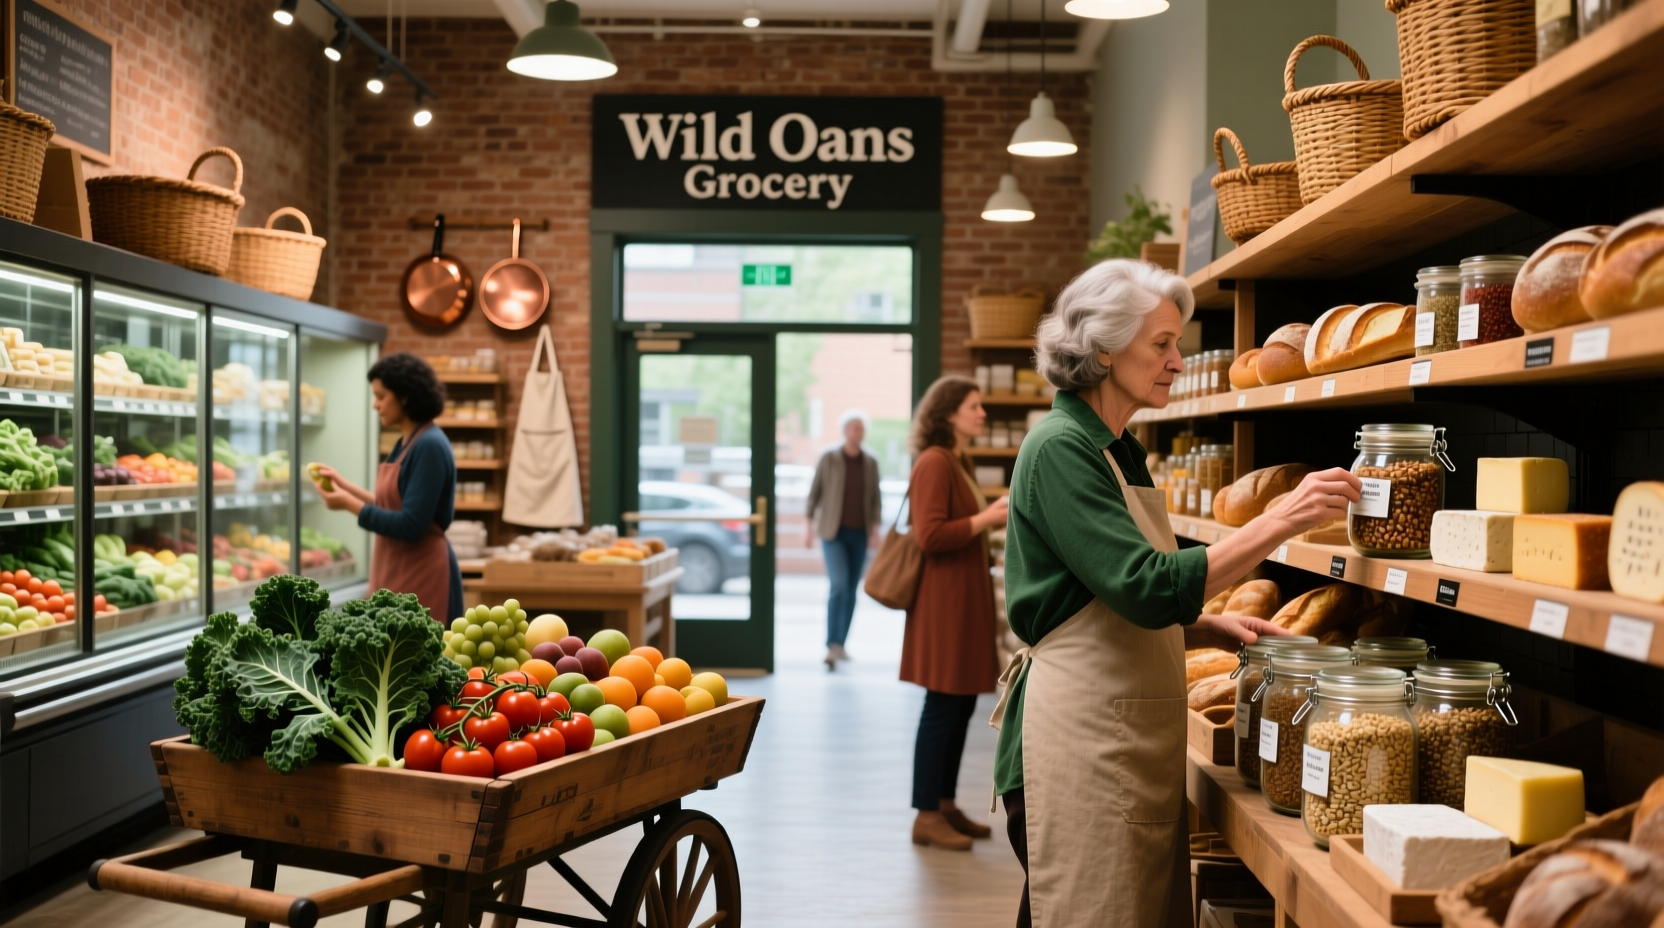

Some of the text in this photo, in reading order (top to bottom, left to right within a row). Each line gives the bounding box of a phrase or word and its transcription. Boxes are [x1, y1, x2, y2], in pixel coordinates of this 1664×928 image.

[618, 110, 915, 163] Wild Oans
[683, 164, 854, 209] Grocery
